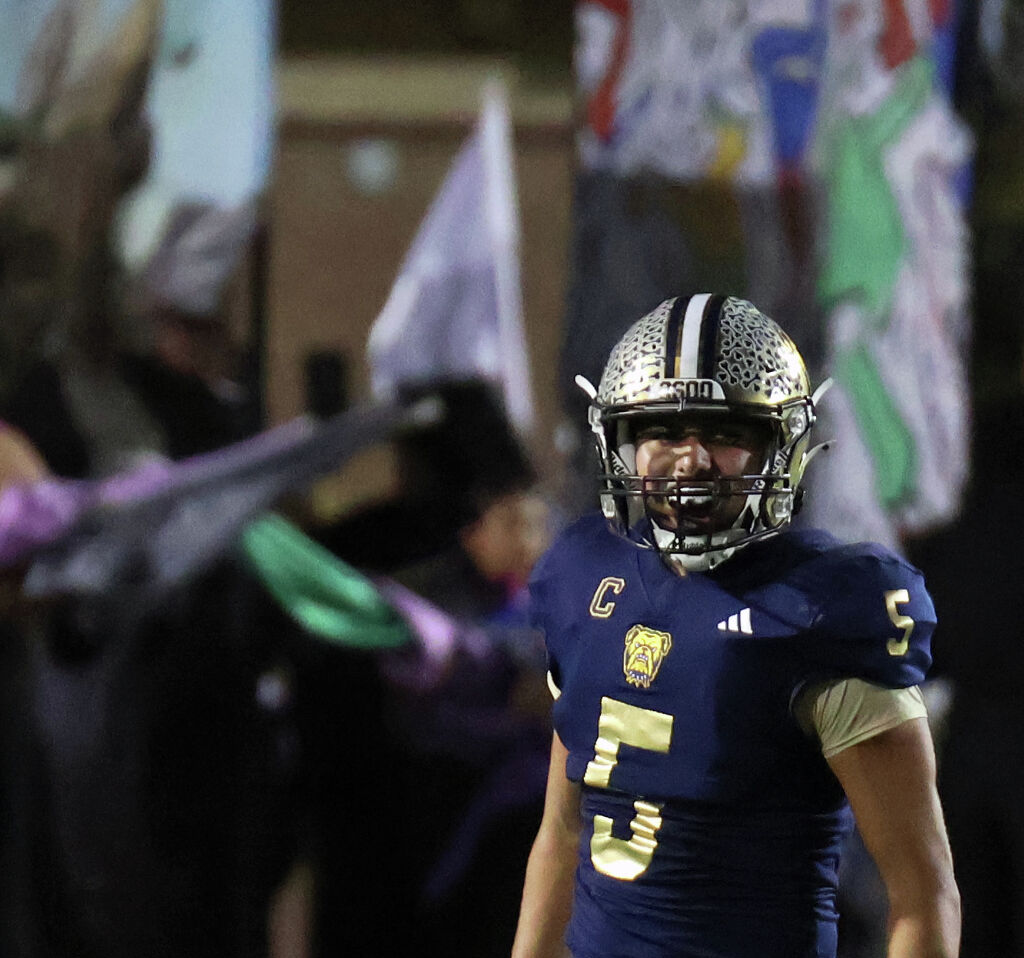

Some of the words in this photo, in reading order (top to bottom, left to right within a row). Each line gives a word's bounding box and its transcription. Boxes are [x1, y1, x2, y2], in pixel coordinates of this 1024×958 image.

[588, 576, 626, 618] C
[883, 588, 915, 657] 5
[583, 696, 674, 881] 5
